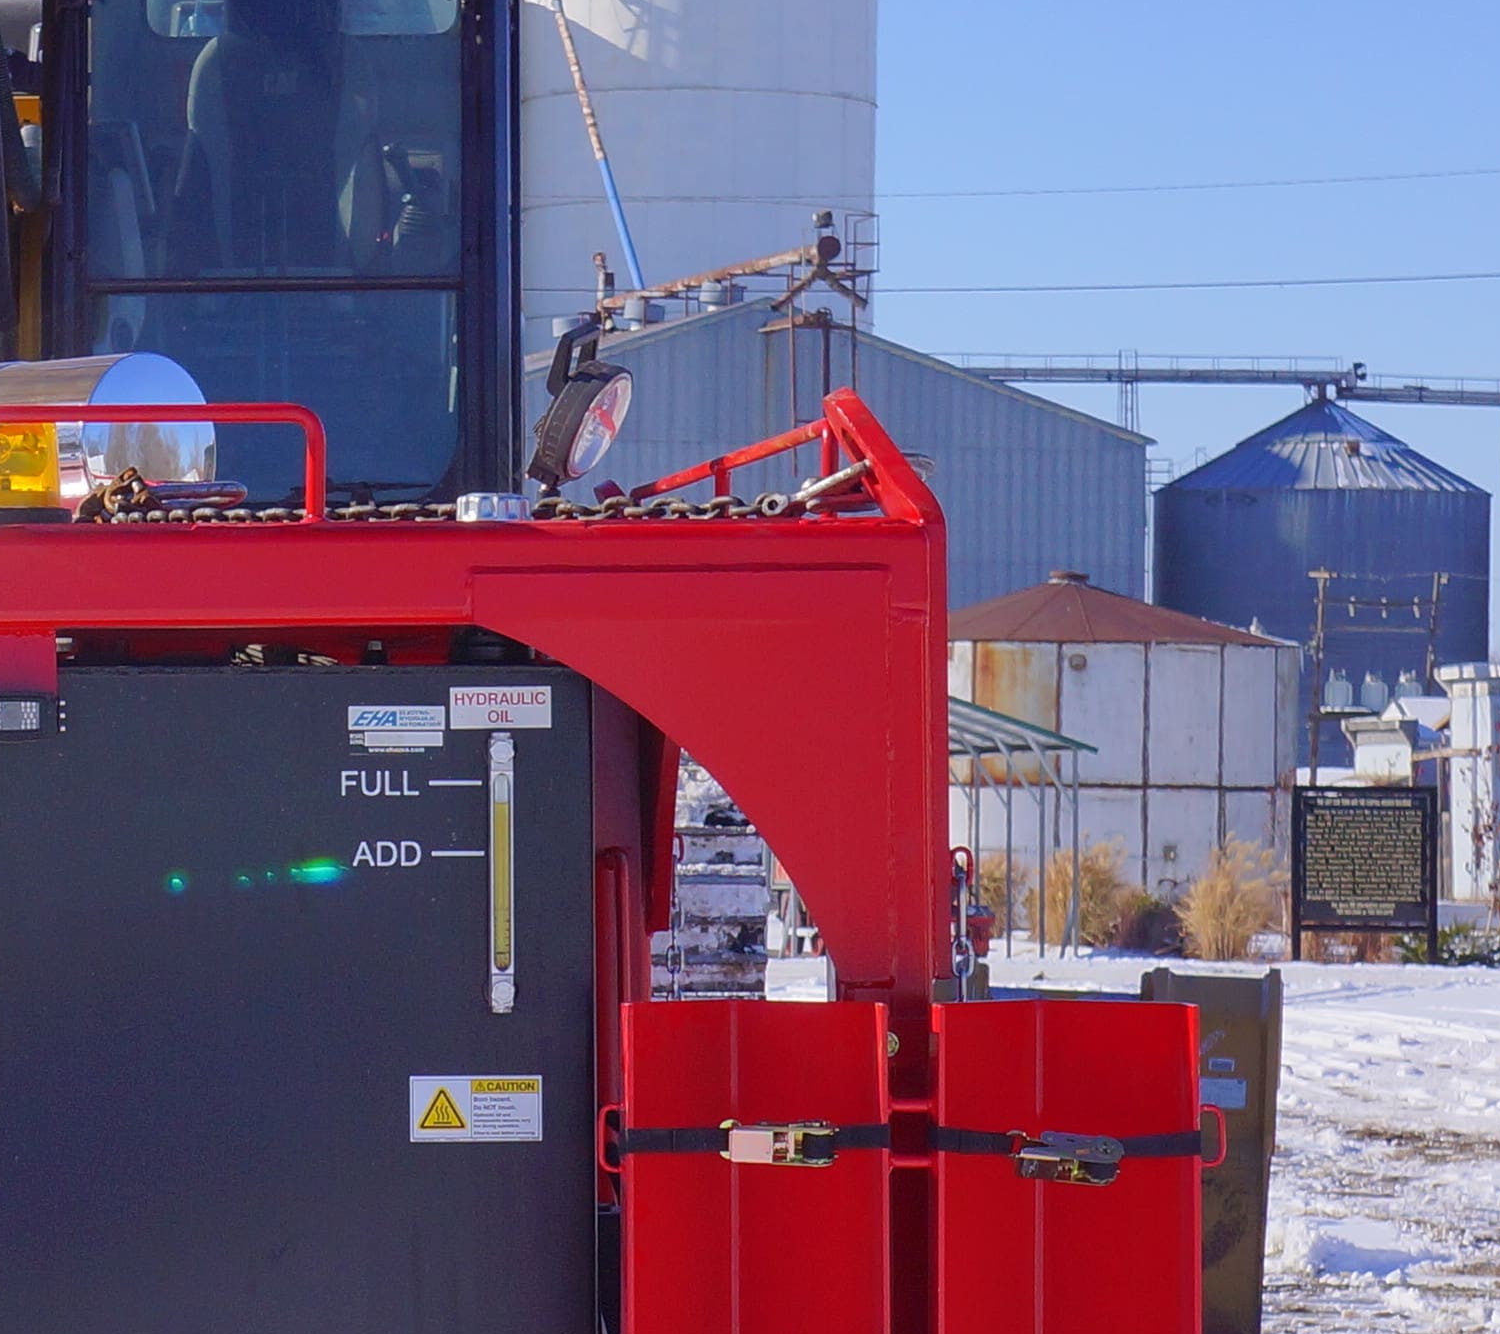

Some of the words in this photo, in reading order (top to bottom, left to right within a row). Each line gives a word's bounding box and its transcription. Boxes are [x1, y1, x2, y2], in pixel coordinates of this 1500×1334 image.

[454, 691, 547, 706] HYDRAULIC
[351, 709, 399, 727] EHA
[487, 710, 514, 723] OIL
[341, 770, 420, 796] FULL
[352, 840, 422, 867] ADD
[486, 1082, 536, 1092] CAUTION
